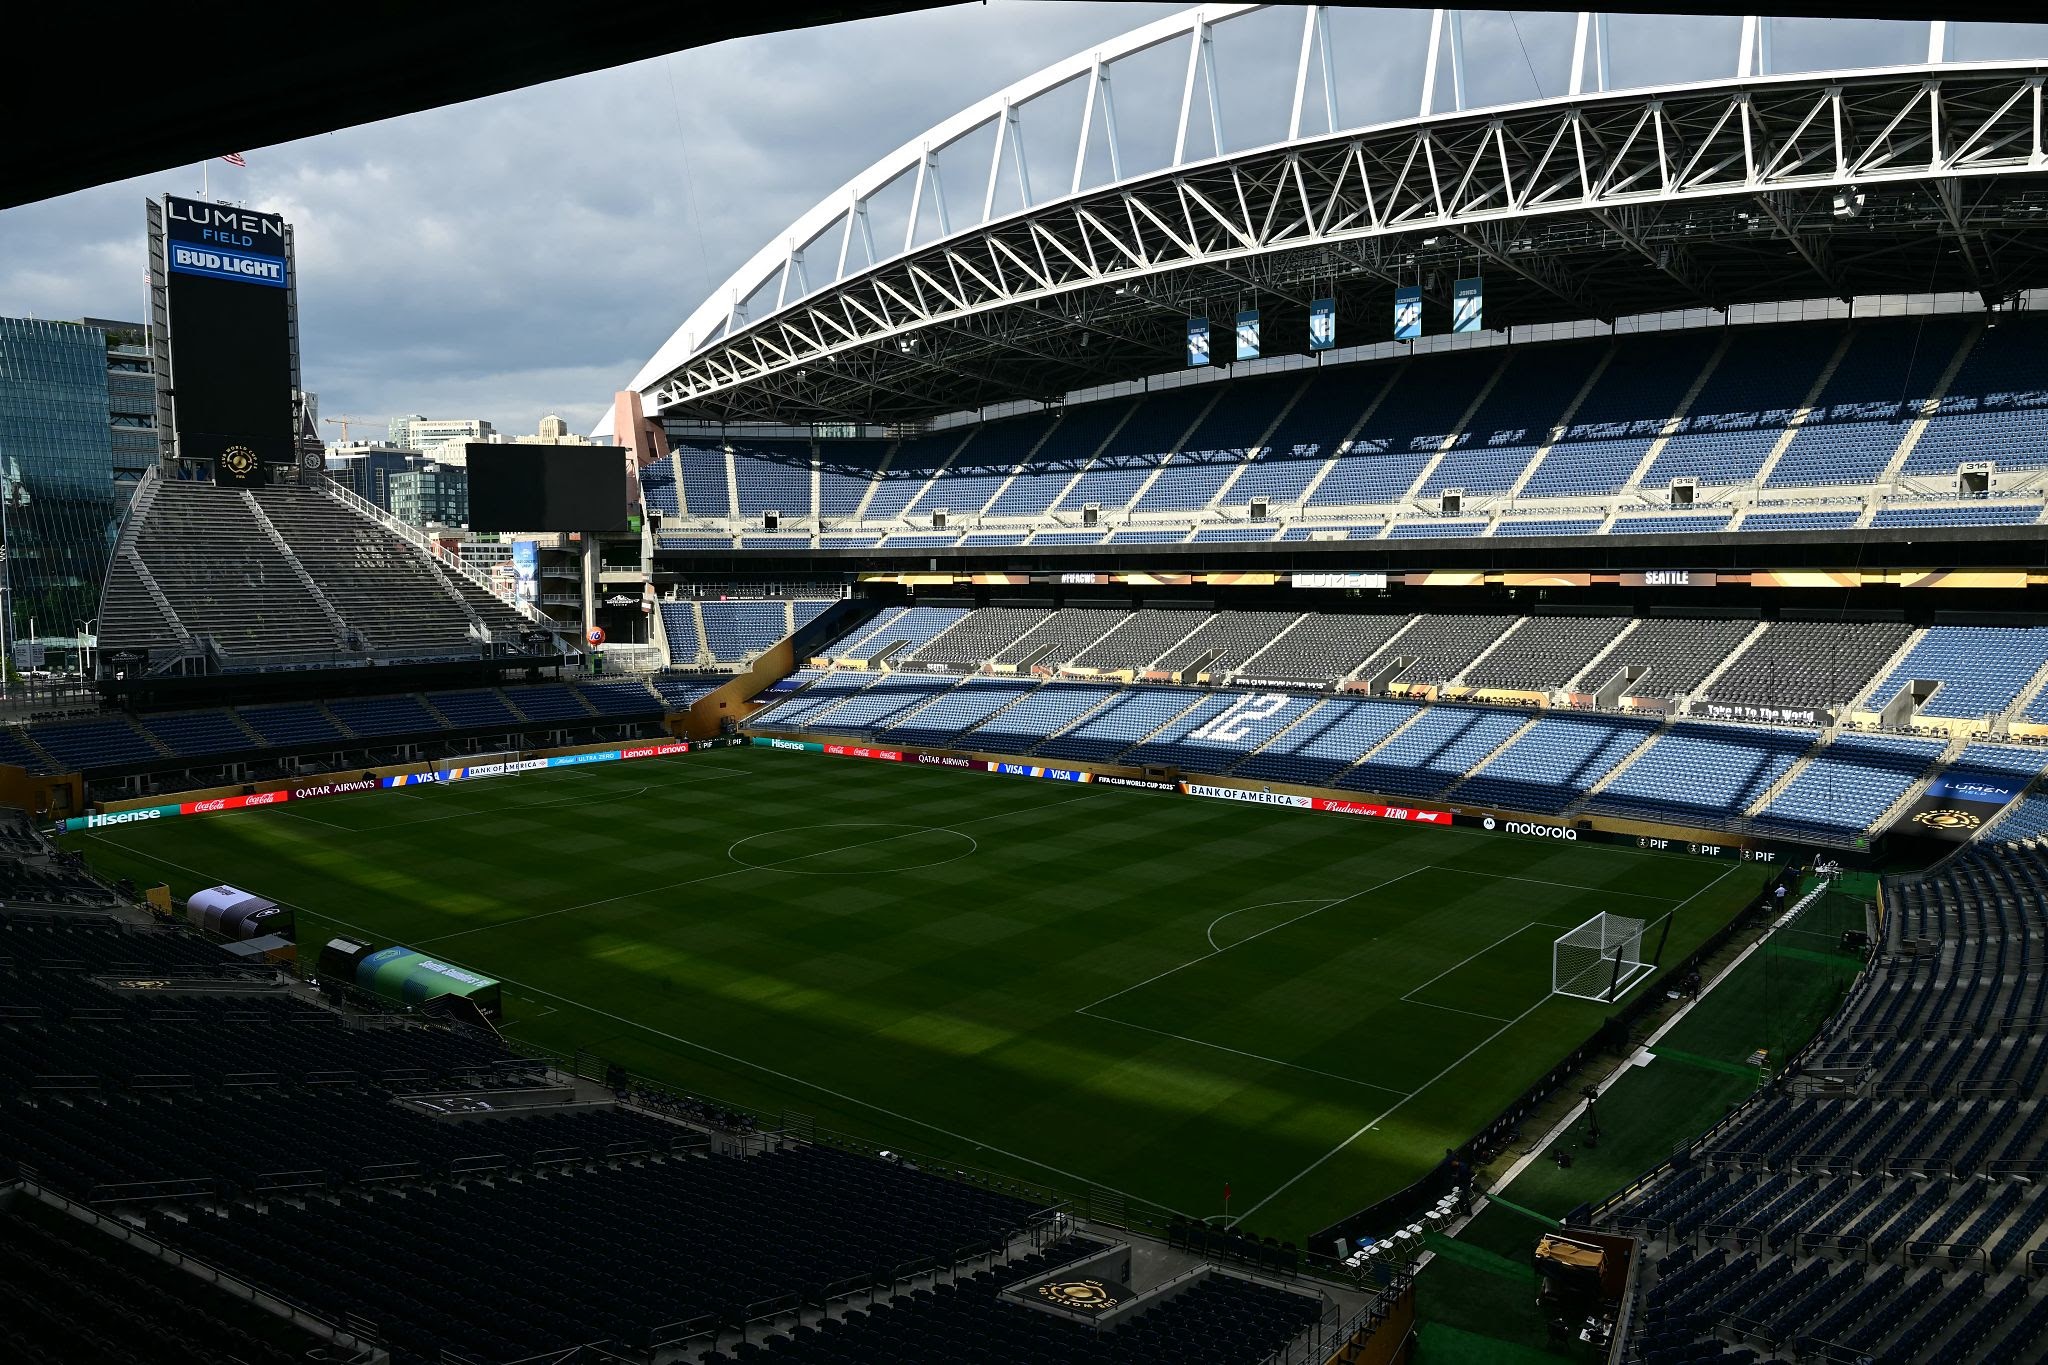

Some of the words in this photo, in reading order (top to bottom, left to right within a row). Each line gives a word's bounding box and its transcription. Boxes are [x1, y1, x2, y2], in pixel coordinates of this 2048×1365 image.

[168, 202, 283, 238] LUMEN
[203, 229, 253, 247] FIELD
[176, 249, 221, 269] BUD
[223, 255, 280, 279] LIGHT
[1966, 462, 1989, 470] 314
[1645, 570, 1689, 585] SEATTLE
[1187, 692, 1290, 740] 12
[1708, 704, 1732, 716] Take
[1734, 706, 1743, 715] It
[1745, 707, 1757, 717] To
[1760, 708, 1779, 719] The
[1782, 709, 1815, 722] World
[623, 749, 654, 759] Lenovo
[657, 745, 687, 755] Lenovo
[771, 738, 805, 750] Hisense
[918, 754, 940, 764] QATAR
[941, 758, 970, 767] AIRWAYS
[470, 765, 491, 775] BANK
[492, 763, 502, 772] OF
[1005, 764, 1024, 775] VISA
[1051, 769, 1071, 781] VISA
[415, 771, 440, 784] VISA
[1098, 776, 1111, 784] FIFA
[1111, 777, 1125, 786] CLUB
[1125, 779, 1146, 788] WORLD
[1147, 781, 1159, 789] CUP
[295, 785, 331, 799] QATAR
[334, 779, 375, 793] AIRWAYS
[1191, 785, 1221, 797] BANK
[1224, 789, 1237, 798] OF
[1240, 791, 1293, 805] AMERICA
[1944, 783, 2009, 794] LUMEN
[1323, 800, 1377, 816] Budweiser
[1383, 807, 1408, 820] ZERO
[88, 809, 161, 828] Hisense
[1505, 821, 1577, 840] motorola
[1650, 839, 1669, 850] PIF
[1701, 845, 1721, 856] PIF
[1755, 851, 1776, 862] PIF
